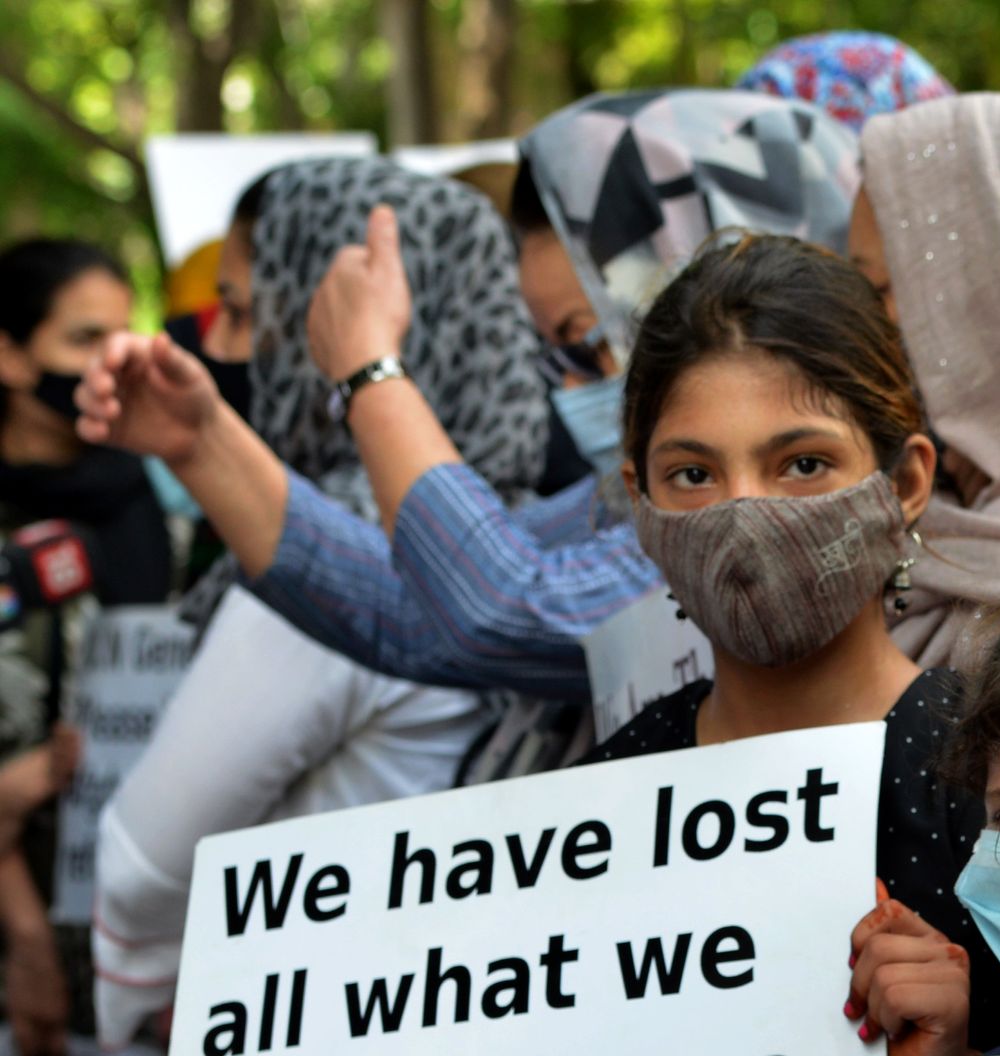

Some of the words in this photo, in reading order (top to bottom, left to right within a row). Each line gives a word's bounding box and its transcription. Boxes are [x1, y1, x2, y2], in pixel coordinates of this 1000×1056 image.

[224, 854, 350, 936] We
[388, 820, 611, 909] have
[653, 768, 838, 867] lost
[345, 935, 578, 1037] what
[617, 926, 755, 999] we
